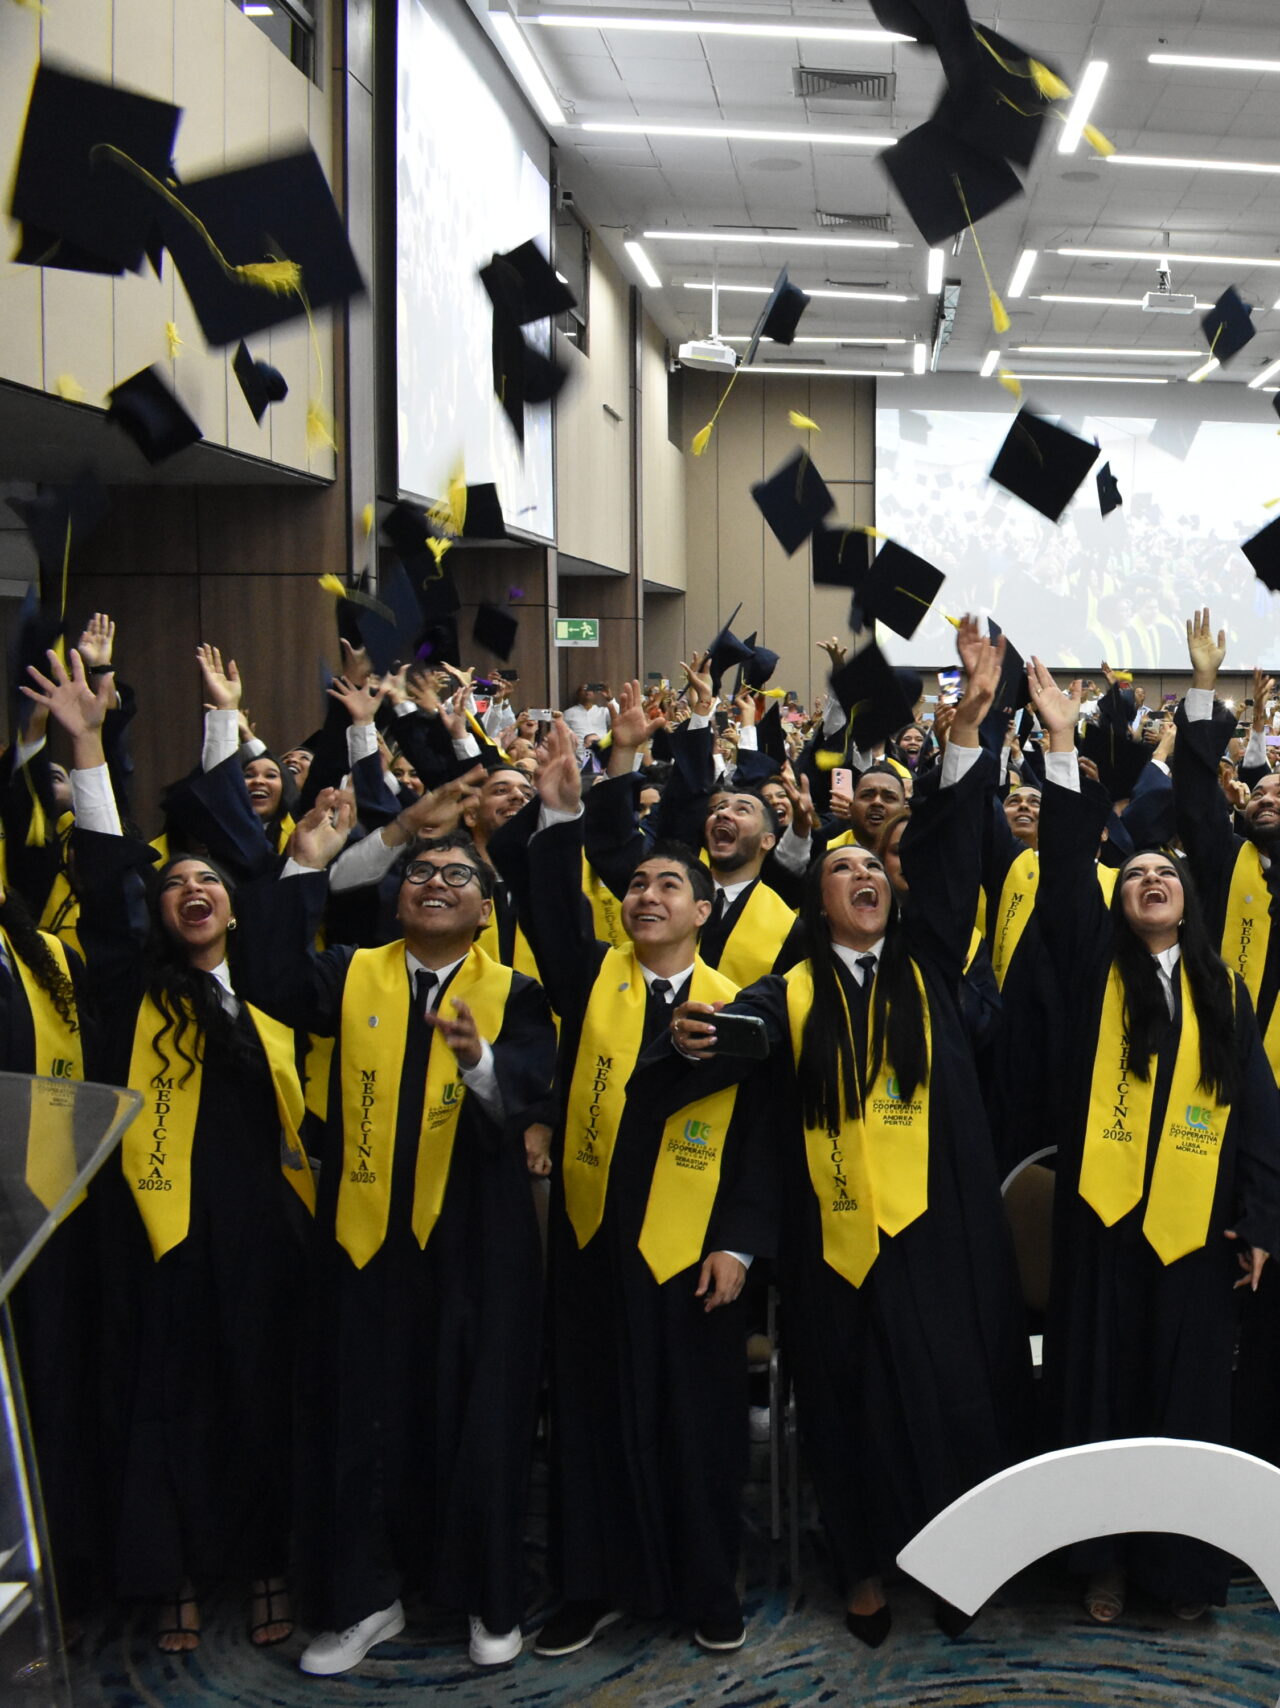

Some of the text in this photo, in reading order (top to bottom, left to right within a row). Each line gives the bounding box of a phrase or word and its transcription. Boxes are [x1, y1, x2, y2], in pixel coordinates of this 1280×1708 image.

[1238, 917, 1254, 980] MEDICI
[585, 1055, 614, 1153] MEDICINA
[873, 1103, 923, 1111] COOPERATIVA
[148, 1077, 174, 1179] MEDICINA
[358, 1070, 377, 1171] MEDICINA
[1103, 1128, 1132, 1142] 2025
[1170, 1127, 1218, 1144] COOPERATIVA
[668, 1142, 716, 1158] COOPERATIVA
[1175, 1145, 1208, 1156] MORALES
[576, 1150, 600, 1168] 2025
[138, 1179, 172, 1191] 2025
[350, 1171, 377, 1184] 2025
[832, 1200, 858, 1212] 2025
